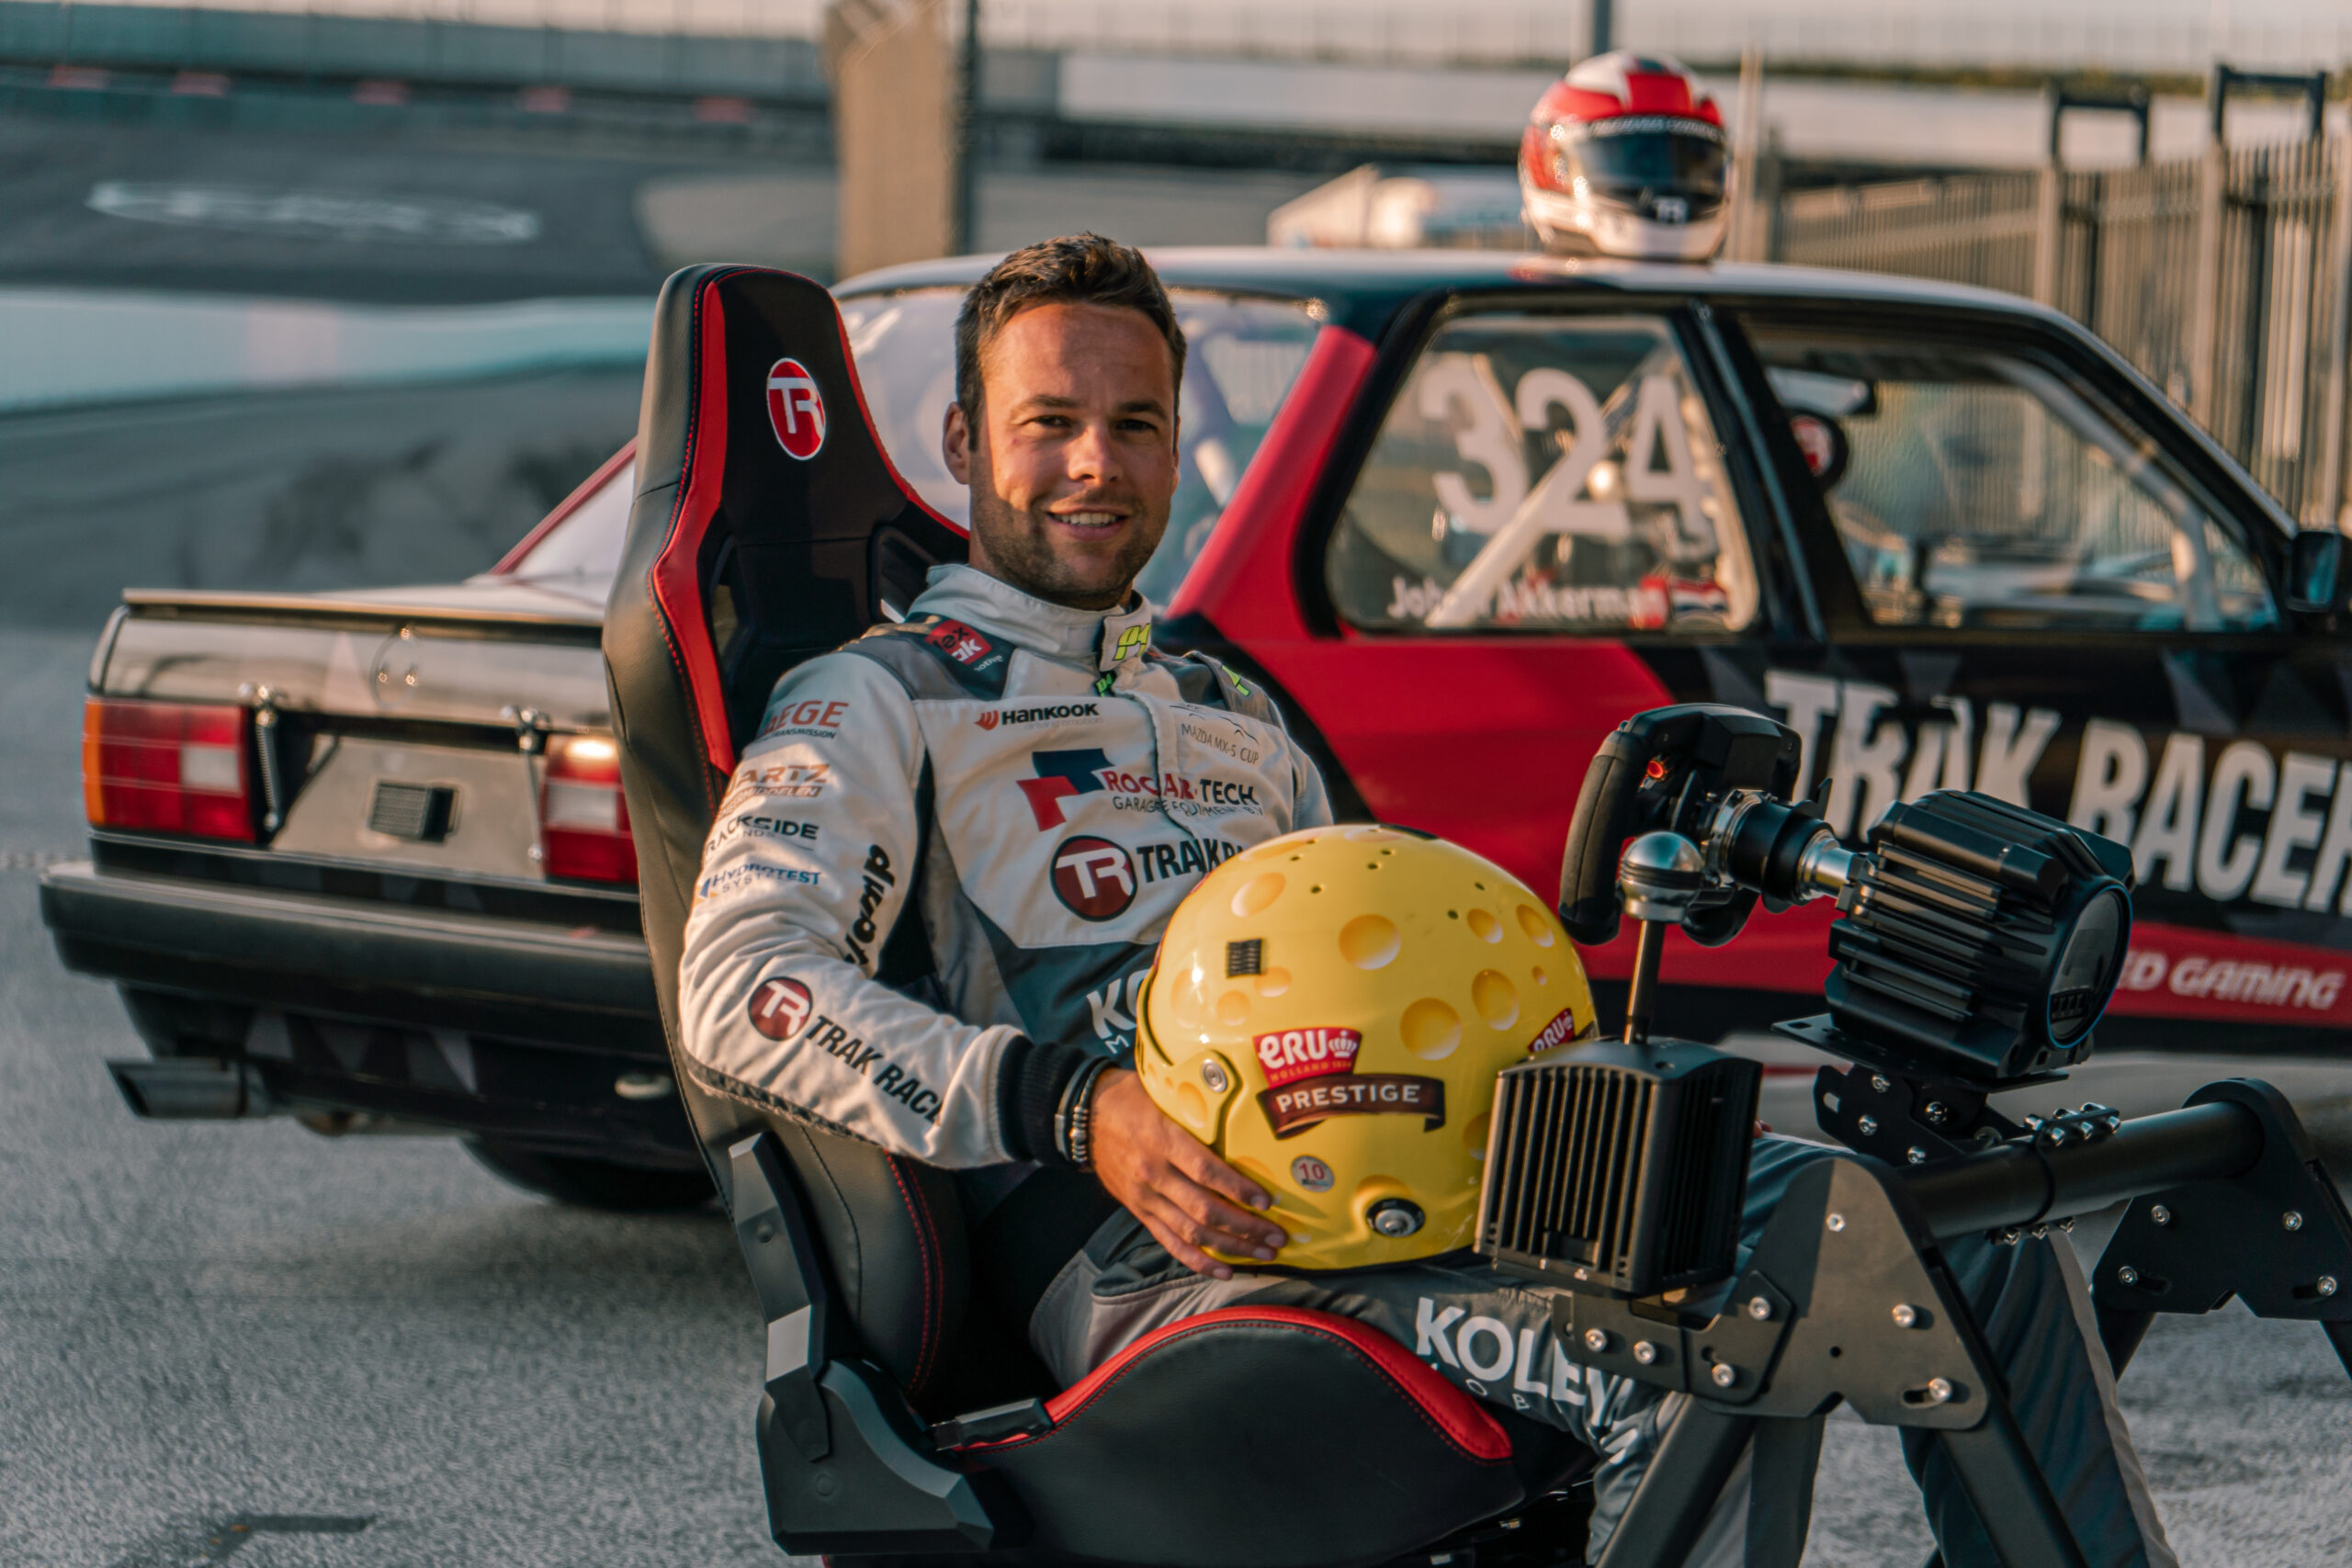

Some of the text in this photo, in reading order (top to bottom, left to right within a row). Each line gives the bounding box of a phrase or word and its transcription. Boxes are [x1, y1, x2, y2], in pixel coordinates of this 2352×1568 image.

[769, 377, 825, 439] TR
[1419, 352, 1714, 548] 324
[1181, 722, 1260, 764] MAZDA MX-5 CUP
[1055, 847, 1135, 899] TR
[761, 979, 810, 1037] TR
[2169, 956, 2344, 1010] GAMING
[804, 1014, 884, 1076] TRAK
[1270, 1062, 1329, 1082] HOLLAND
[1275, 1084, 1421, 1113] PRESTIGE
[1298, 1162, 1325, 1180] 10
